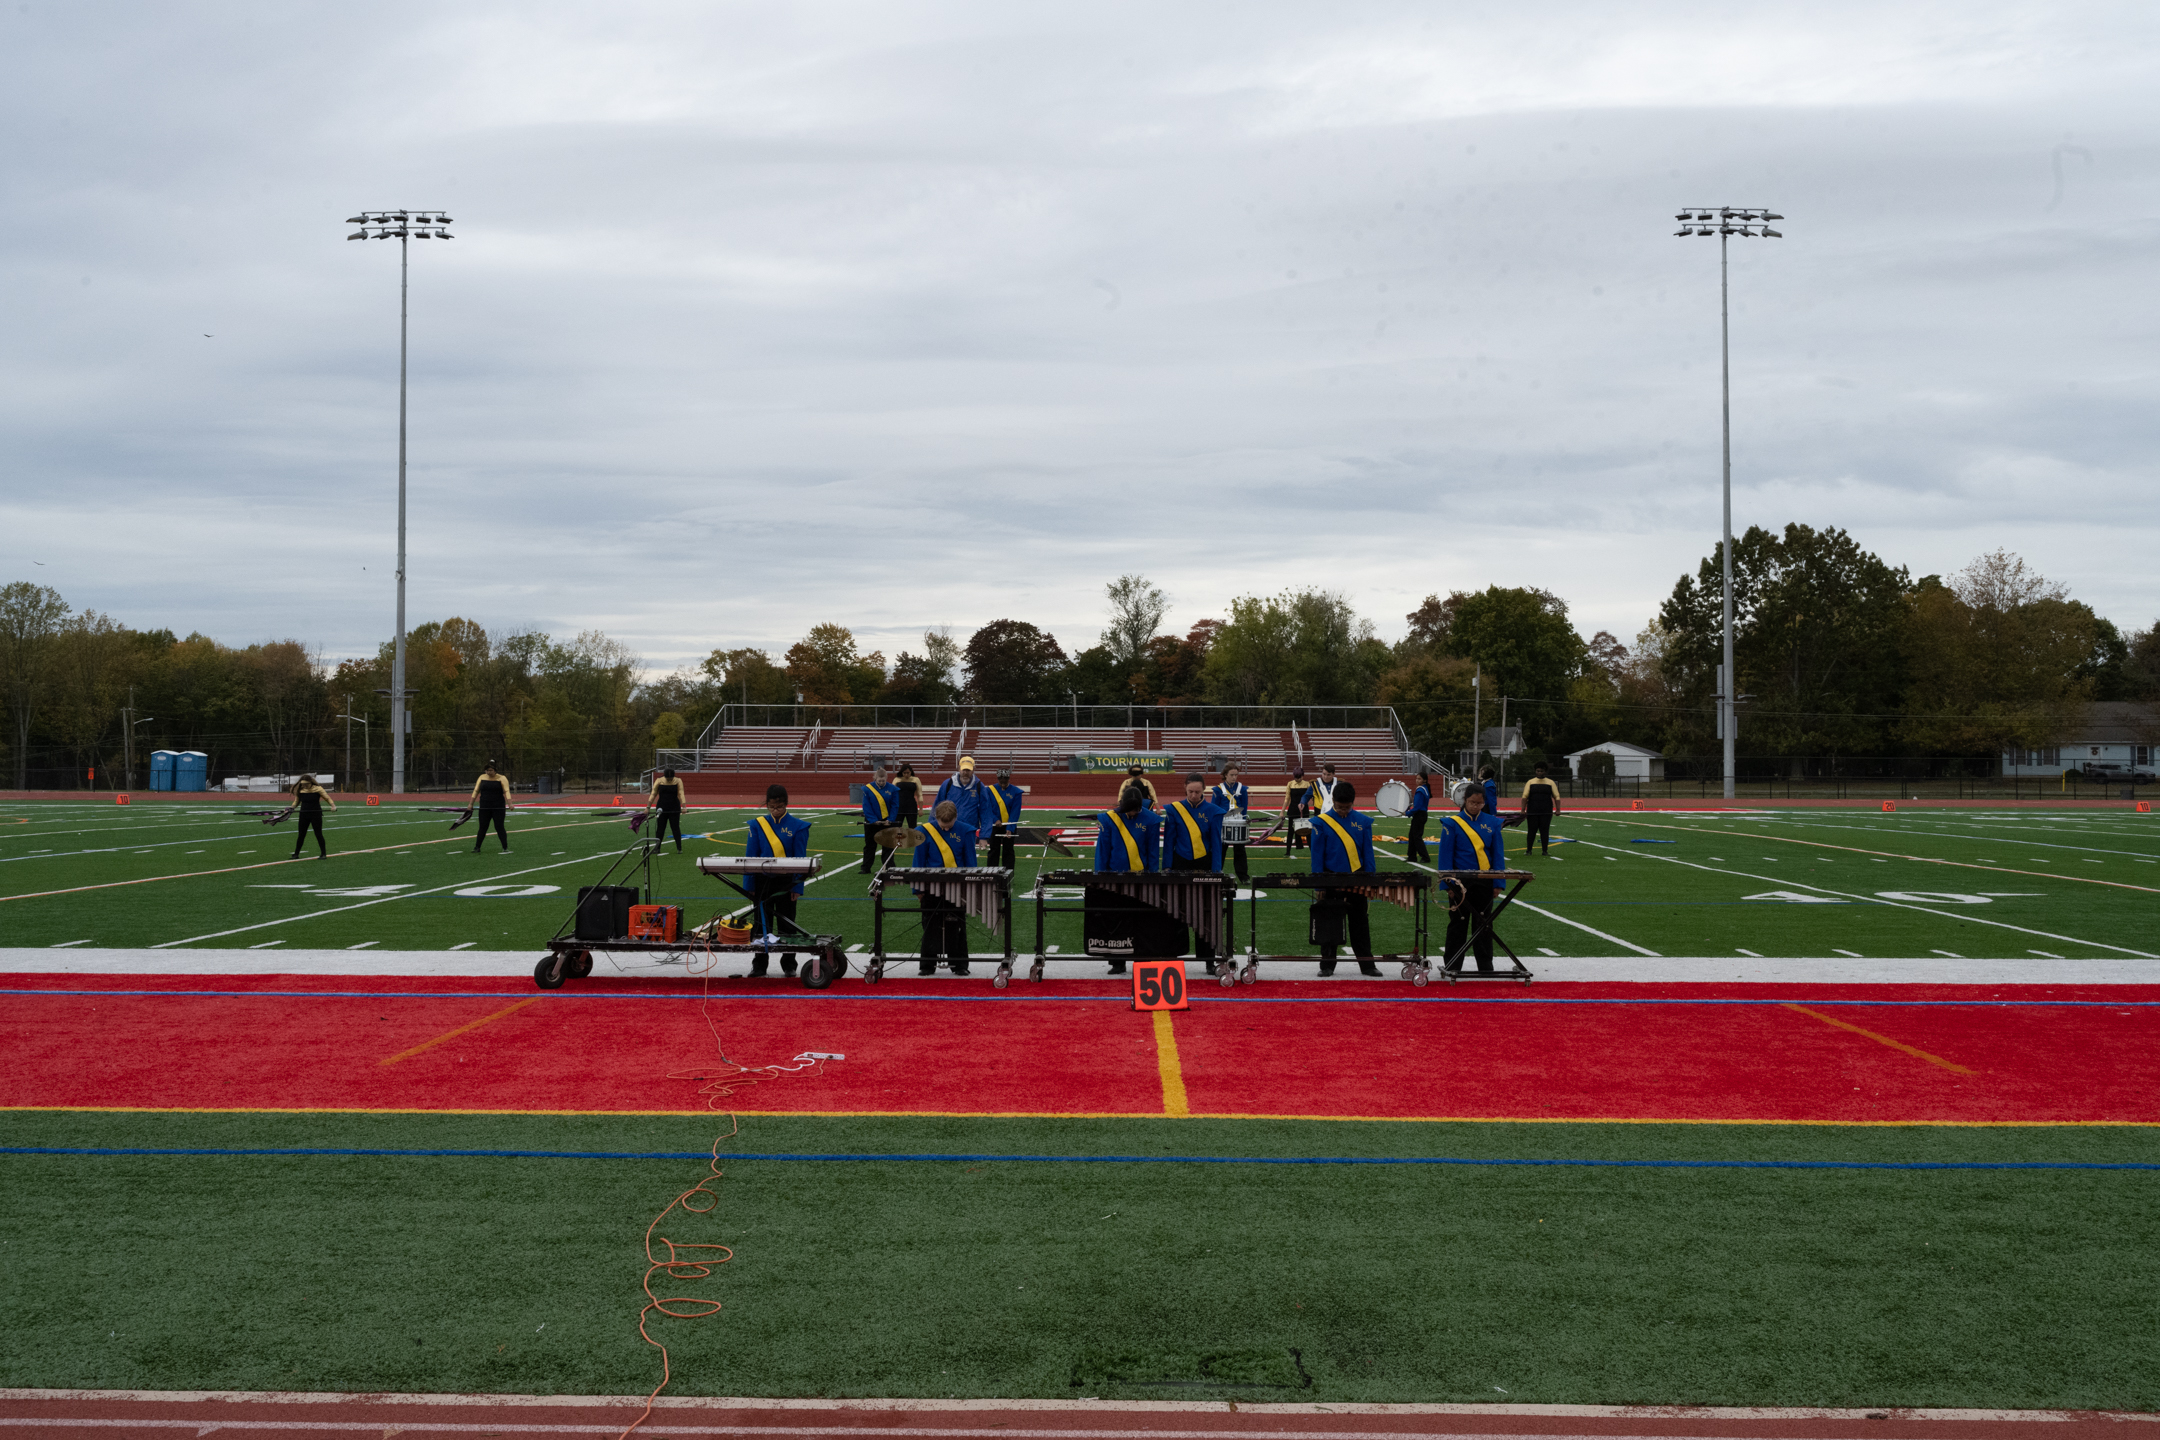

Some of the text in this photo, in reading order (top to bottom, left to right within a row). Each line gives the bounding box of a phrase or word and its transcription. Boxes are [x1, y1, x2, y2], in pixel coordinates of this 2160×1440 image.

[1095, 757, 1169, 767] TOURNAMENT
[120, 795, 128, 804] 10
[367, 796, 377, 805] 20
[1633, 801, 1644, 810] 30
[1885, 801, 1895, 811] 20
[2140, 802, 2150, 811] 10
[1197, 812, 1209, 823] MS
[1135, 822, 1147, 832] MS
[1350, 821, 1363, 831] MS
[1480, 823, 1493, 834] MS
[781, 826, 793, 837] MS
[949, 832, 961, 842] MS
[1138, 966, 1183, 1006] 50
